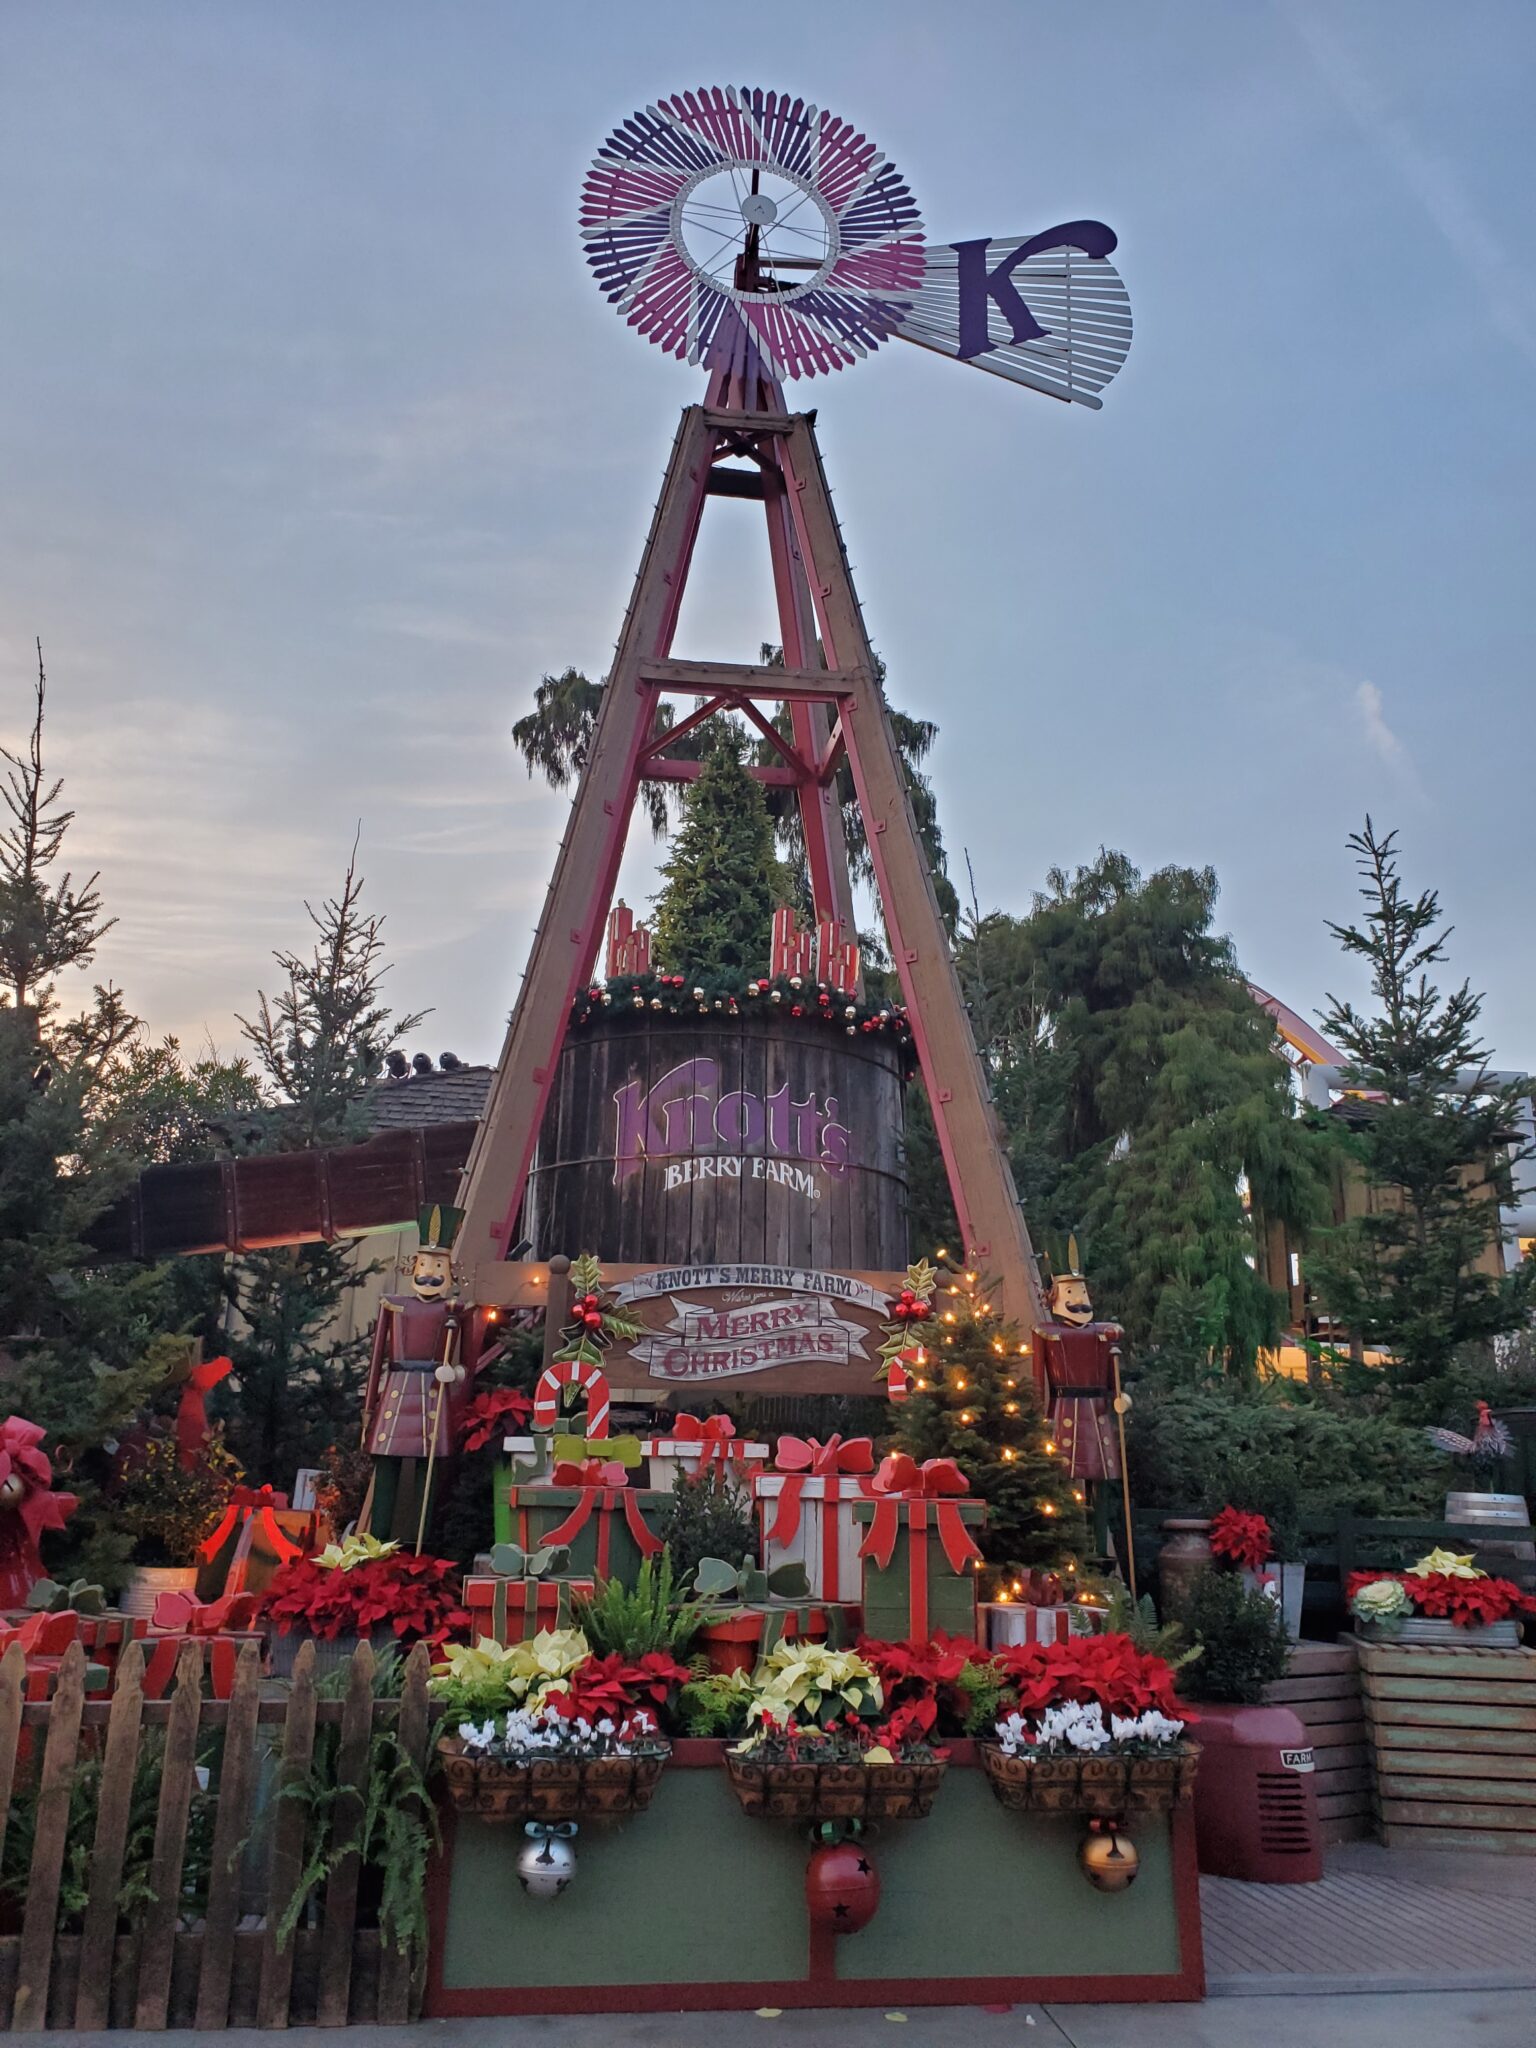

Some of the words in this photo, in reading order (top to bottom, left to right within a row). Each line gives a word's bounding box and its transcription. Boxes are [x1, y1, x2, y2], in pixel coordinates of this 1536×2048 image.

[949, 220, 1118, 360] K
[612, 1057, 852, 1186] Knott's
[663, 1156, 745, 1192] BERRY
[656, 1268, 731, 1290] KNOTT'S
[735, 1267, 796, 1287] MERRY
[803, 1273, 852, 1297] FARM
[695, 1304, 810, 1342] MERRY
[664, 1332, 834, 1377] CHRISTMAS
